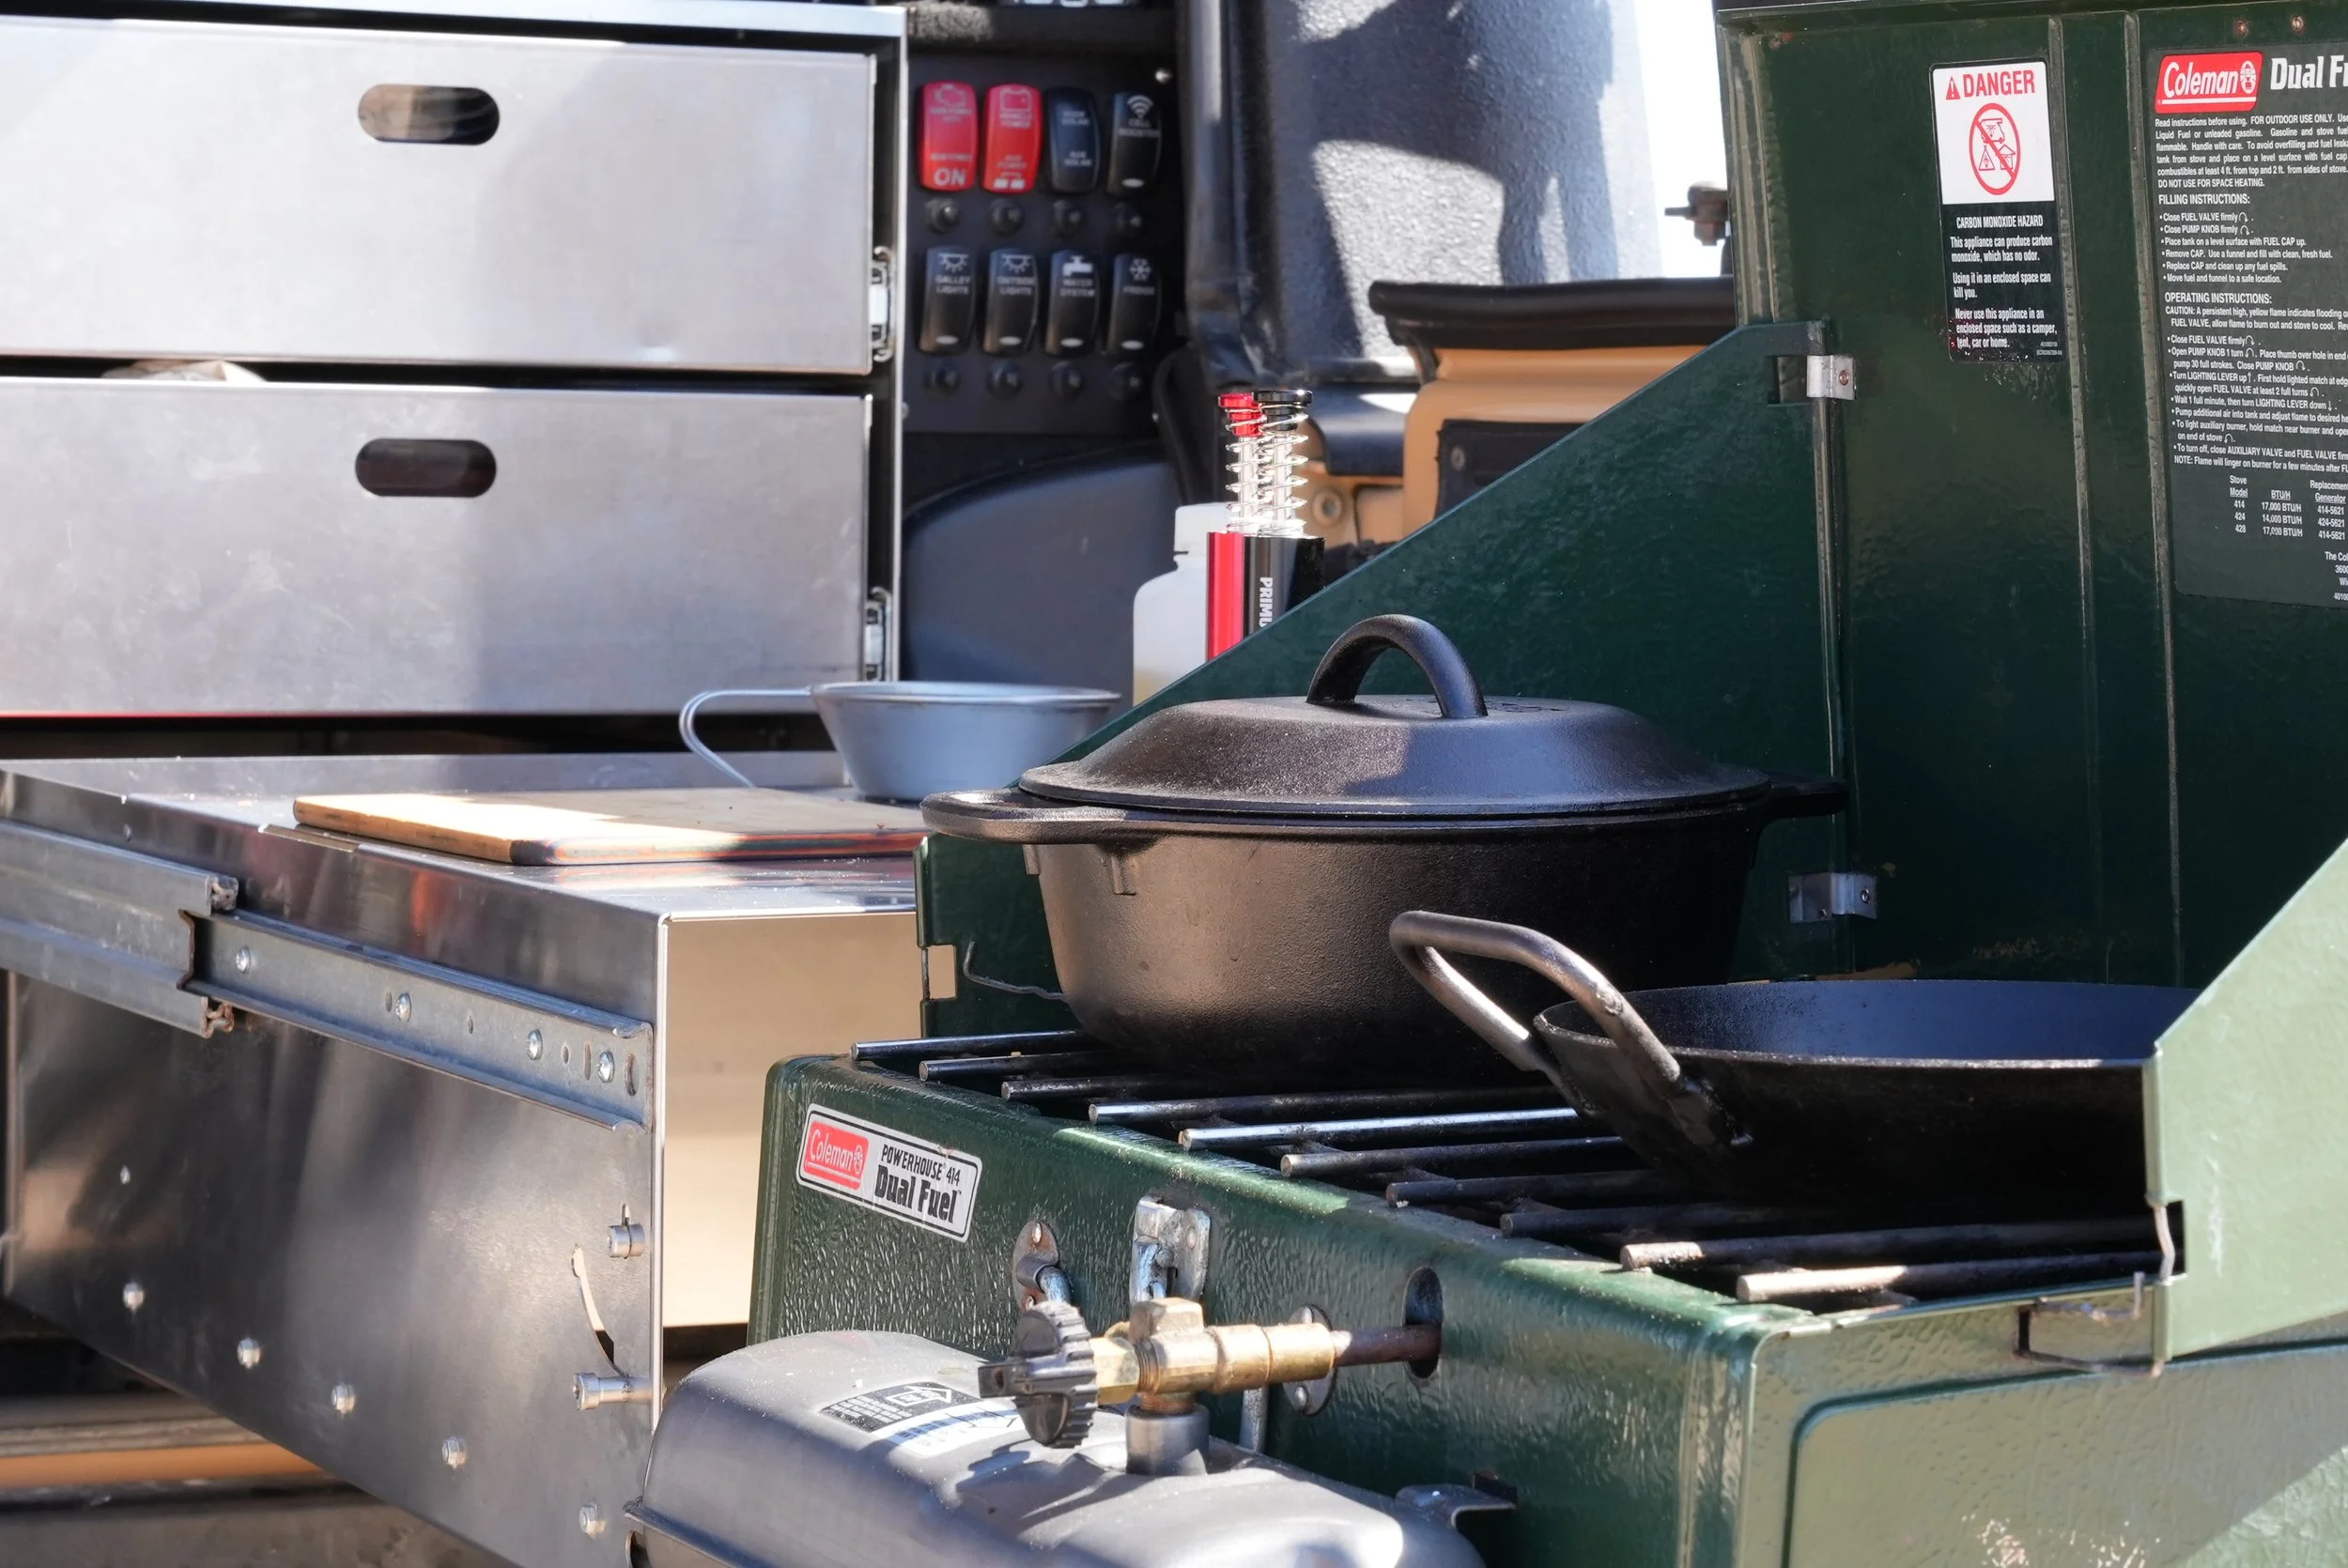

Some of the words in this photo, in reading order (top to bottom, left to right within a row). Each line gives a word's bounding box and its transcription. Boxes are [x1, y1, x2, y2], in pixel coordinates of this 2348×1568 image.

[2270, 55, 2325, 90] Dual
[1962, 69, 2035, 98] DANGER
[2163, 61, 2238, 99] Coleman
[2155, 118, 2170, 128] Read
[2171, 117, 2207, 128] instructions
[2208, 116, 2228, 126] before
[2229, 115, 2248, 128] using.
[2250, 115, 2264, 125] FOR
[2265, 115, 2298, 125] OUTDOOR
[2299, 114, 2313, 123] USE
[2314, 114, 2335, 123] ONLY.
[934, 167, 967, 187] ON
[2157, 179, 2168, 188] DO
[2169, 178, 2182, 188] NOT
[2183, 178, 2196, 188] USE
[2197, 178, 2211, 188] FOR
[2212, 177, 2233, 188] SPACE
[2234, 177, 2265, 187] HEATING.
[2158, 193, 2188, 205] FILLING
[2189, 193, 2250, 205] INSTRUCTIONS:
[1956, 217, 1982, 229] CARBON
[1983, 215, 2016, 227] MONOXIDE
[2016, 214, 2043, 226] HAZARD
[2163, 212, 2180, 222] Close
[2181, 212, 2198, 222] FUEL
[2198, 212, 2220, 222] VALVE
[2220, 212, 2238, 223] firmly
[2164, 224, 2181, 234] Close
[2182, 224, 2200, 234] PUMP
[2201, 224, 2220, 234] KNOB
[2220, 224, 2238, 236] firmly
[1950, 236, 1963, 248] This
[1964, 236, 1993, 250] appliance
[1994, 238, 2005, 247] can
[2006, 235, 2031, 249] produce
[2031, 234, 2053, 246] carbon
[1952, 250, 1983, 263] monoxide,
[1984, 250, 2001, 262] which
[2002, 250, 2014, 261] has
[2015, 253, 2023, 261] no
[2023, 250, 2040, 261] odor.
[1953, 272, 1970, 286] Using
[1976, 271, 1983, 284] in
[1984, 273, 1992, 284] an
[1992, 271, 2020, 284] enclosed
[2020, 272, 2039, 285] space
[2040, 273, 2051, 283] can
[1954, 286, 1963, 298] kill
[1964, 288, 1977, 300] you.
[2164, 292, 2210, 303] OPERATING
[2211, 292, 2272, 304] INSTRUCTIONS:
[1954, 308, 1972, 319] Never
[1973, 310, 1985, 319] use
[1985, 308, 1997, 319] this
[1998, 307, 2028, 321] appliance
[2029, 307, 2035, 319] in
[2035, 310, 2045, 319] an
[1984, 324, 2001, 335] space
[2002, 322, 2017, 333] such
[2017, 324, 2026, 333] as
[2031, 324, 2057, 335] camper,
[1971, 339, 1982, 347] car
[1982, 339, 1989, 347] or
[1990, 337, 2010, 347] home.
[2229, 475, 2248, 484] Stove
[2230, 487, 2248, 497] Model
[2271, 490, 2291, 500] BTU/H
[2315, 493, 2346, 503] Generator
[810, 1129, 854, 1173] Coleman
[881, 1144, 943, 1181] POWERHOUSE
[946, 1166, 961, 1187] 414
[874, 1164, 917, 1209] Dual
[918, 1178, 958, 1223] Fuel
